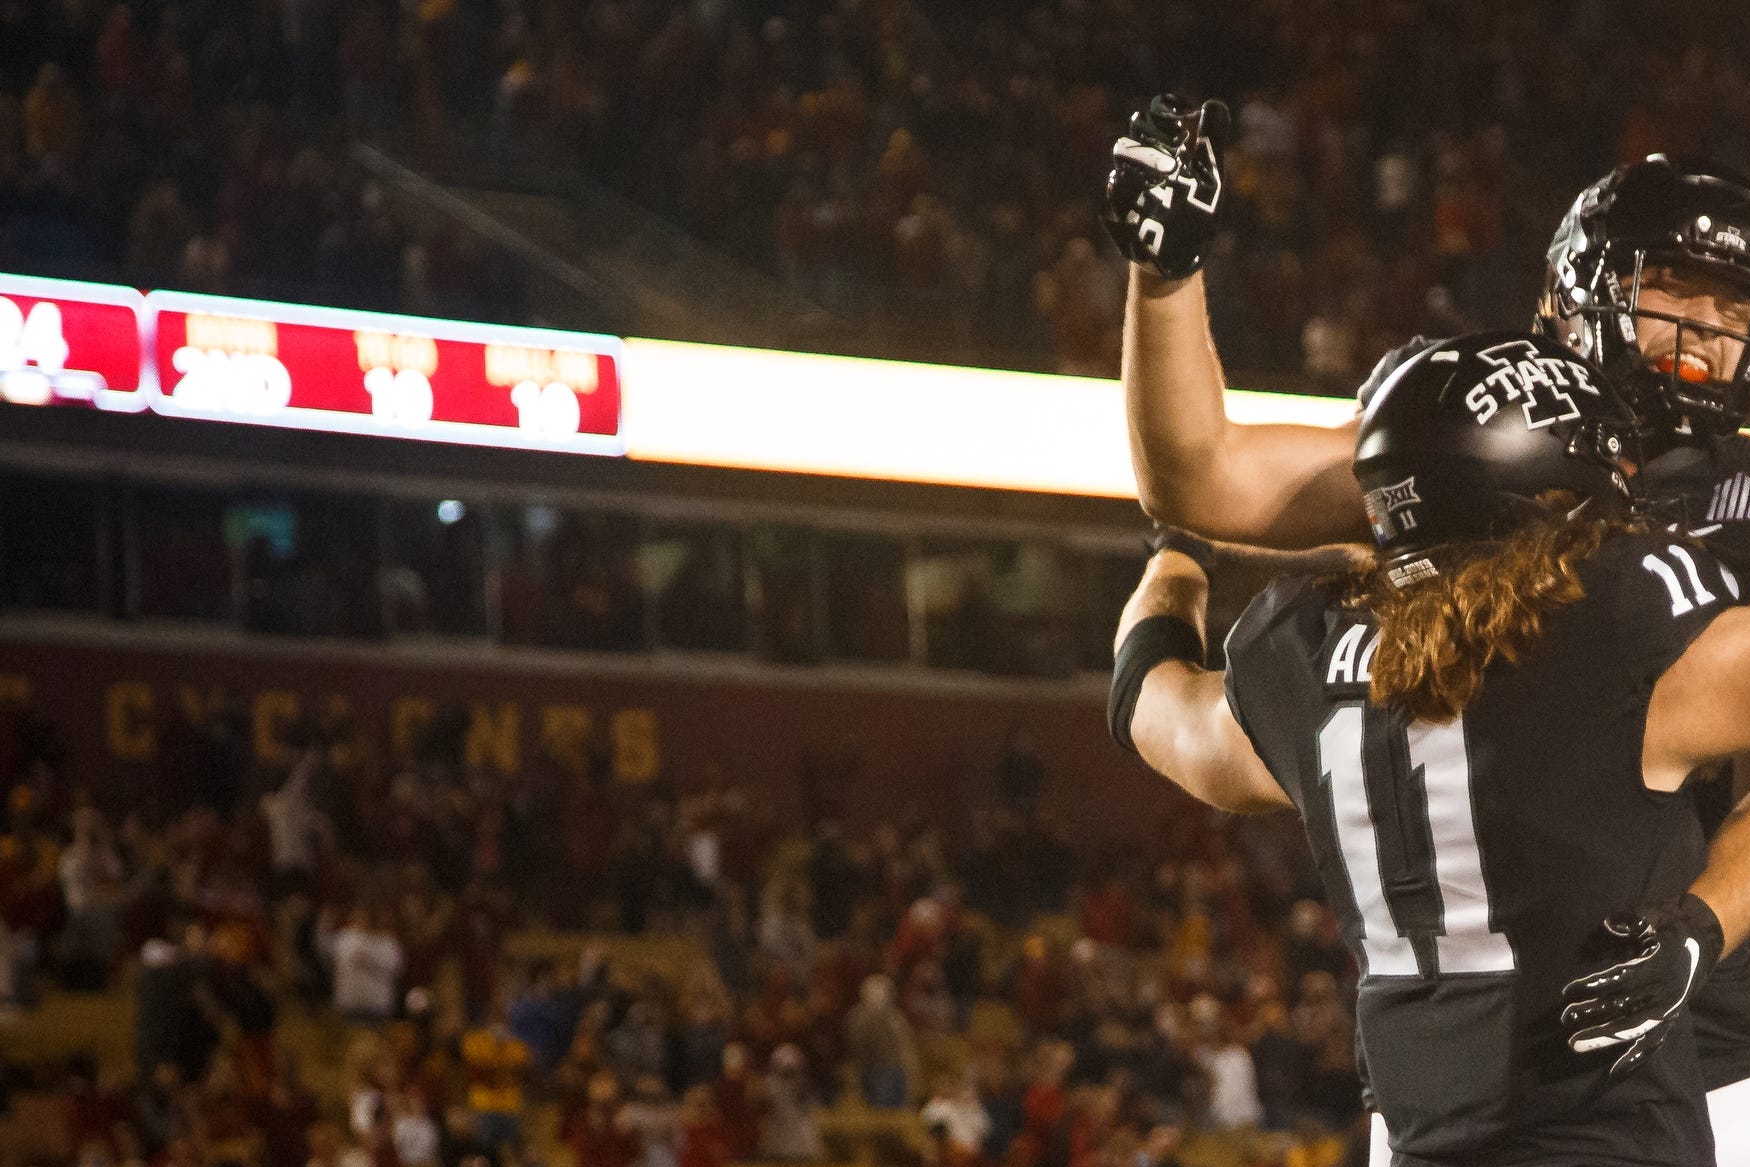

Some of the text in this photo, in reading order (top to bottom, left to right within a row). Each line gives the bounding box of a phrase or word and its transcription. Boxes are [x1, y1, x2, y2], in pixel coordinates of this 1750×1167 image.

[1465, 357, 1600, 425] STATE
[1642, 544, 1717, 618] 11
[1319, 706, 1515, 976] 11
